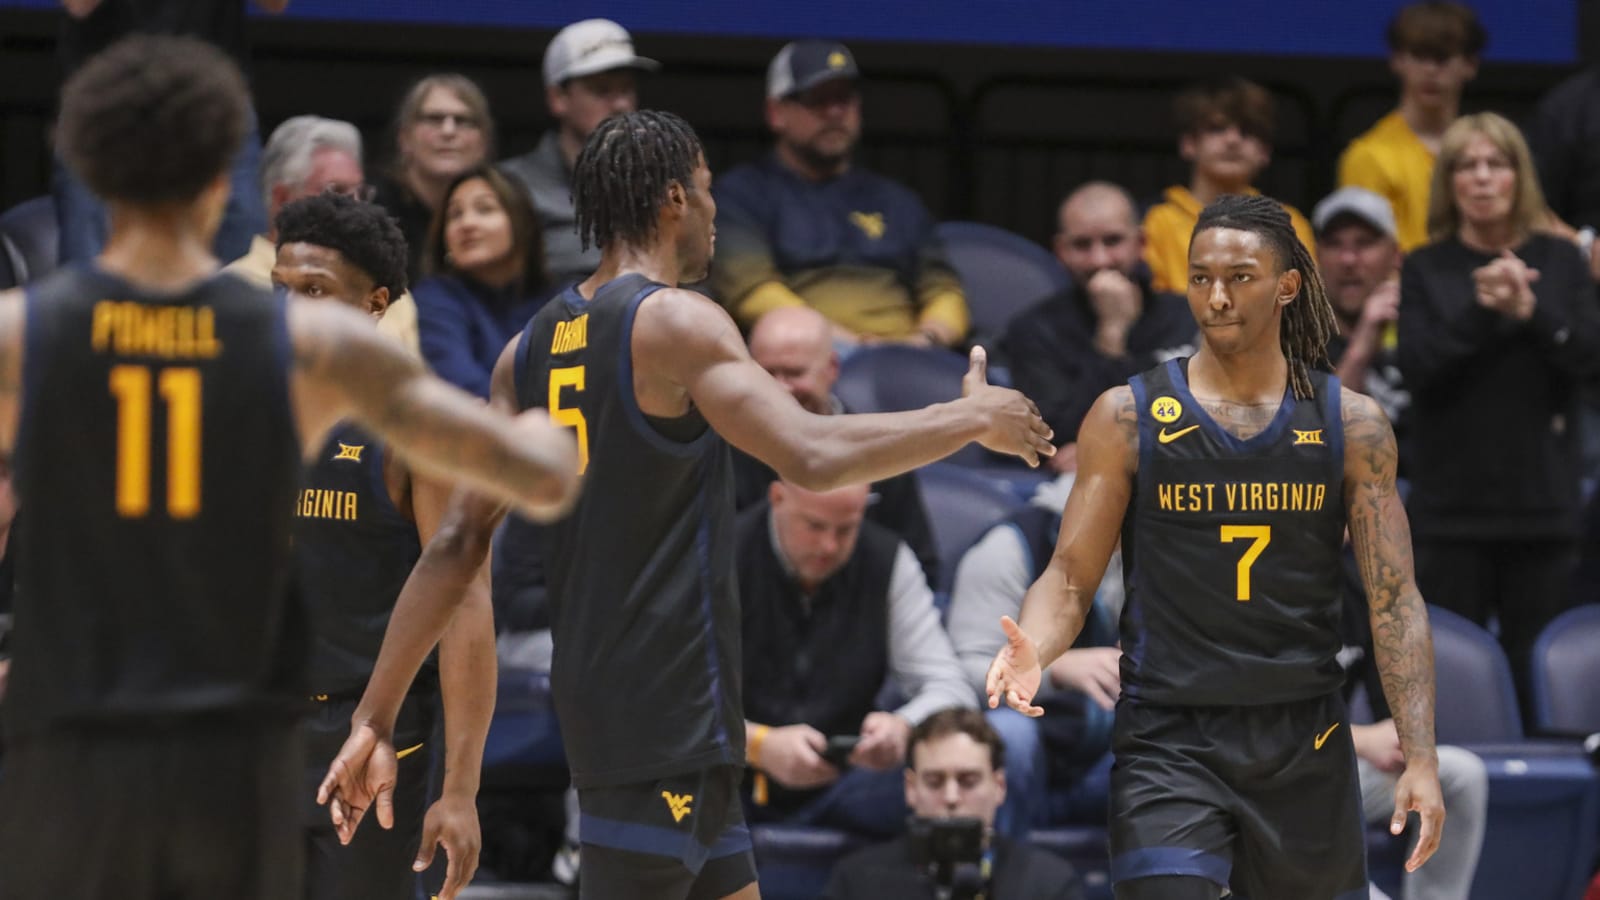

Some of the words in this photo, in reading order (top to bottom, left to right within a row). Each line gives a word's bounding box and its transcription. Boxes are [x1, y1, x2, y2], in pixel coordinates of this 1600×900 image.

[109, 364, 201, 519] 11
[549, 365, 589, 476] 5
[1157, 406, 1176, 417] 44
[1158, 483, 1215, 511] WEST
[1225, 482, 1326, 511] VIRGINIA
[1220, 524, 1271, 601] 7
